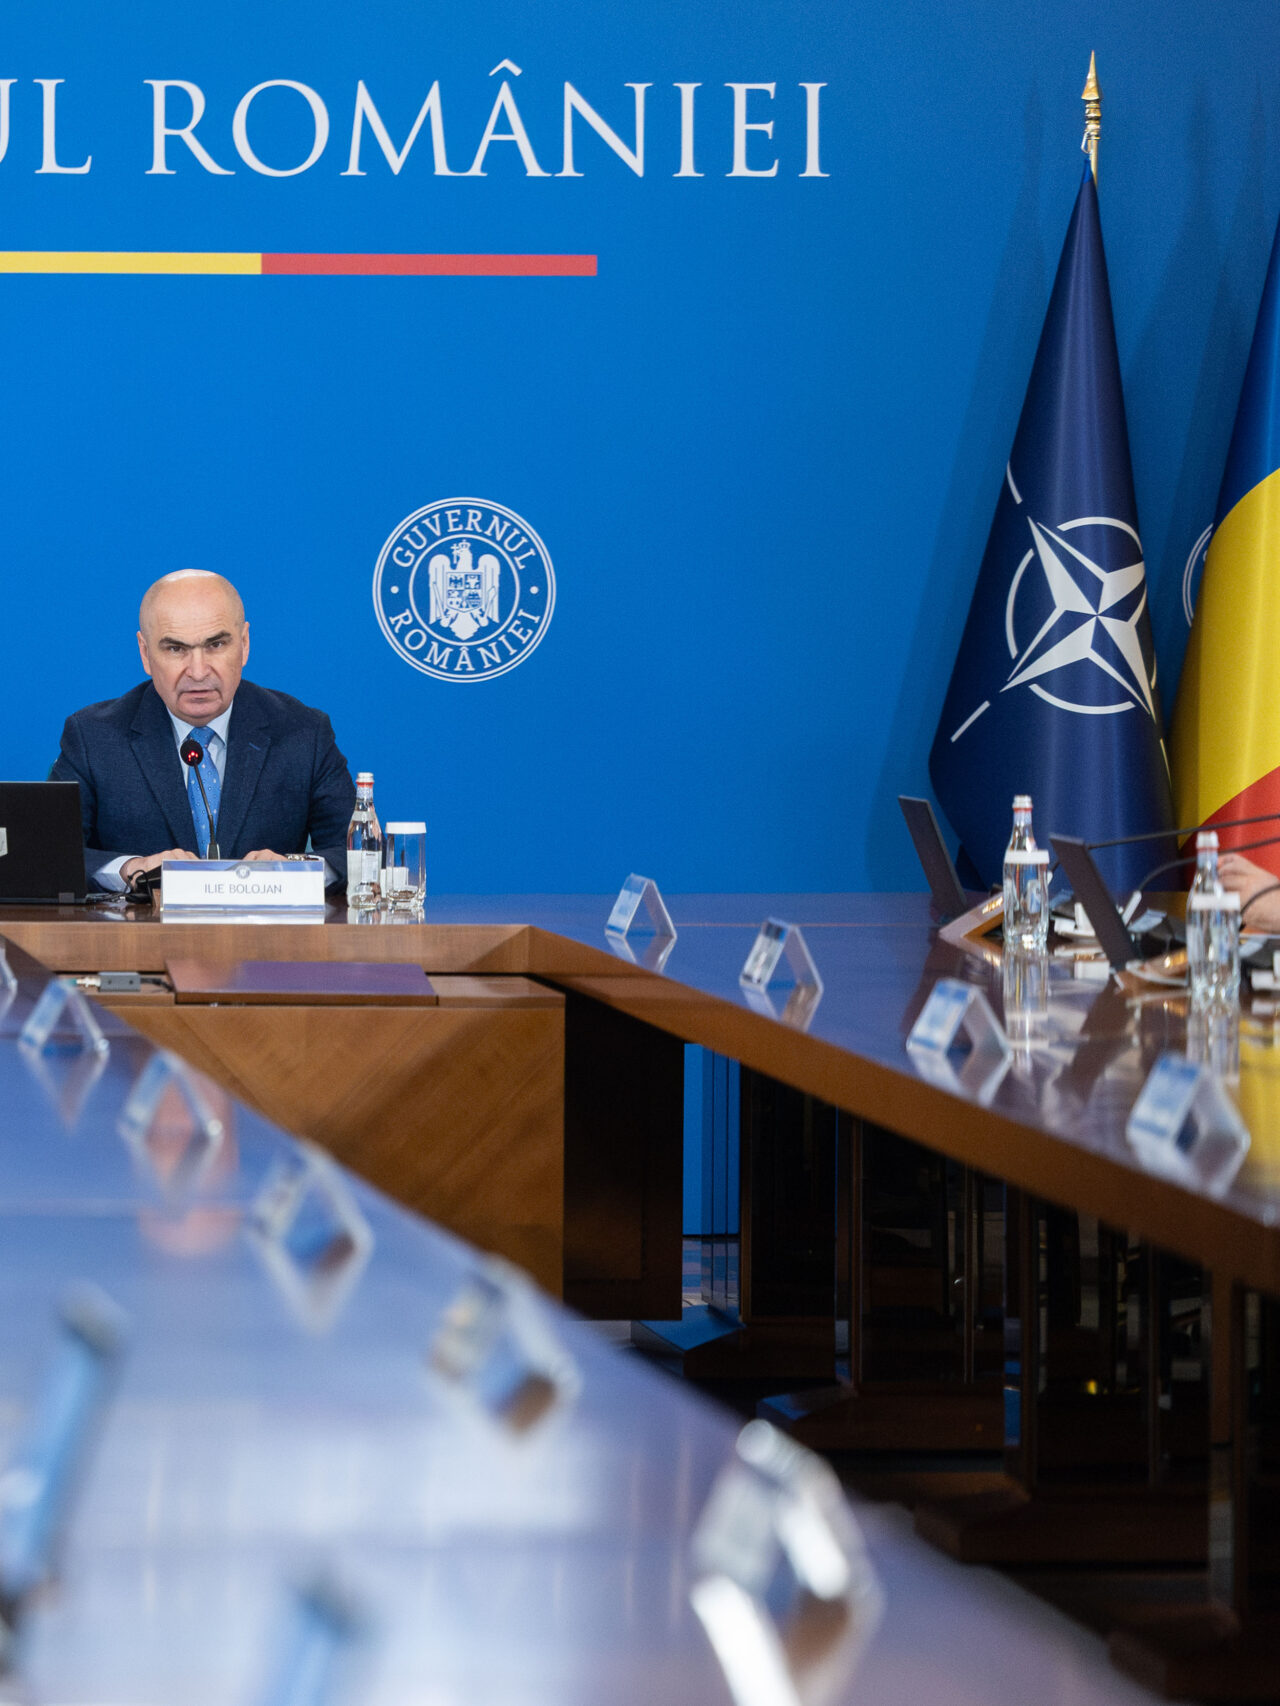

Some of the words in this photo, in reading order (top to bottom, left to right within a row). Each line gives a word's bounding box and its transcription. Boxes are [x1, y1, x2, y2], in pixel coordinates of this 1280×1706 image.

[142, 58, 831, 178] ROMÂNIEI
[392, 508, 536, 570] GUVERNUL
[389, 608, 541, 672] ROMÂNIEI
[204, 883, 224, 894] ILIE
[229, 883, 282, 894] BOLOJAN
